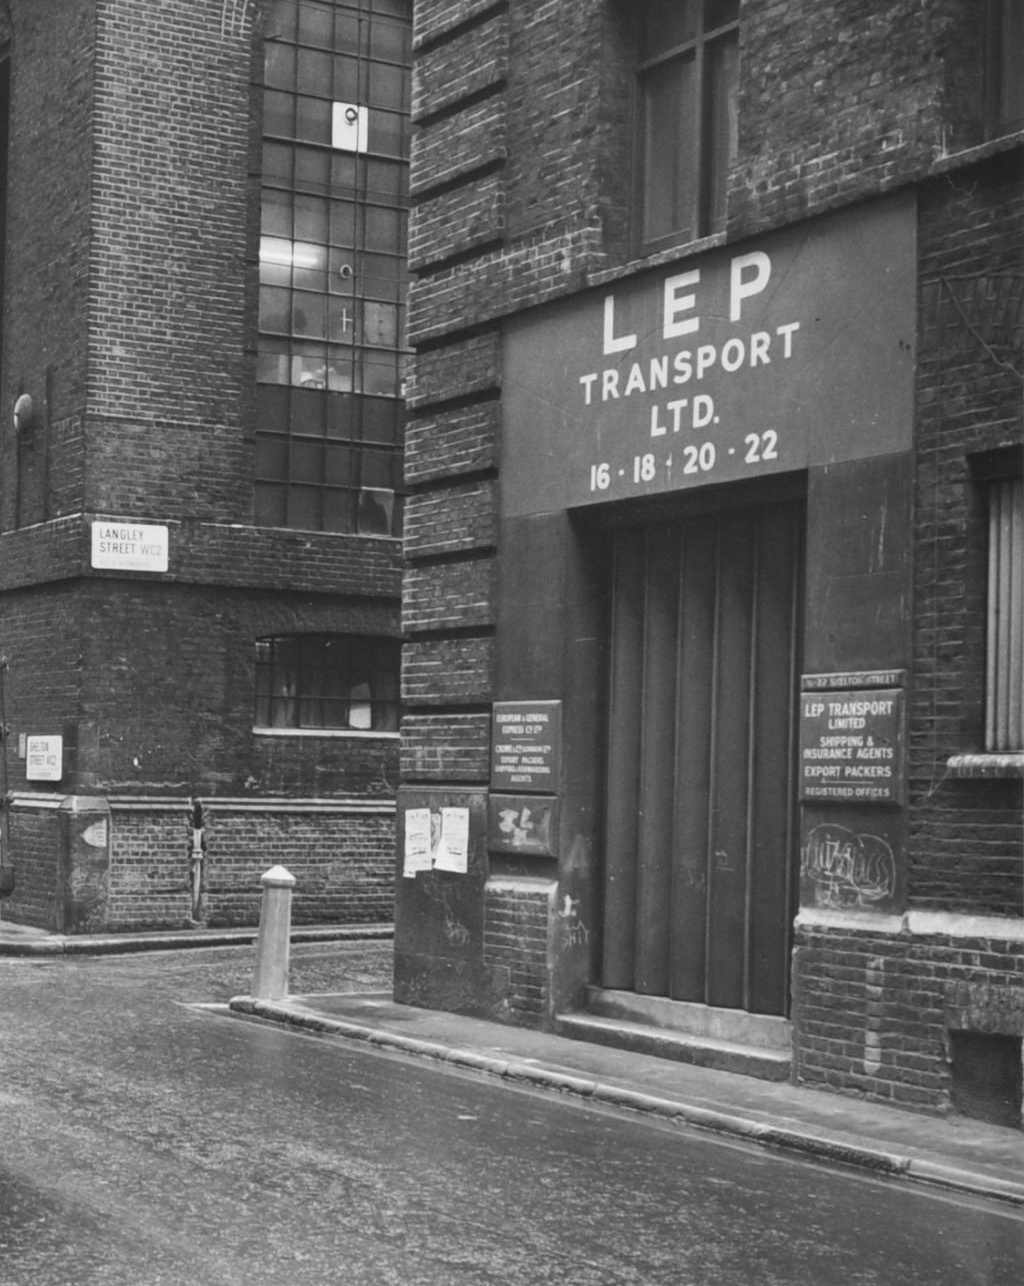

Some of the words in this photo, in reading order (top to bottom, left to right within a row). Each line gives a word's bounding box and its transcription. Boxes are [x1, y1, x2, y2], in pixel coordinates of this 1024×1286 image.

[603, 251, 772, 356] LEP
[579, 321, 801, 406] TRANSPORT
[651, 394, 720, 438] LTD.
[590, 462, 611, 492] 16
[633, 453, 657, 484] 18
[682, 441, 717, 475] 20
[744, 428, 779, 464] 22
[99, 528, 145, 541] LANGLEY
[99, 542, 136, 555] STREET
[140, 545, 162, 556] WC2
[804, 703, 825, 717] LEP
[828, 701, 893, 716] TRANSPORT
[828, 717, 866, 730] LIMITED
[820, 735, 864, 748] SHIPPING
[866, 735, 874, 747] &
[803, 748, 853, 760] INSURANCE
[856, 748, 894, 760] AGENTS
[804, 766, 841, 778] EXPORT
[844, 766, 892, 778] PACKERS
[805, 786, 854, 797] REGISTERED
[855, 787, 890, 798] OFFICES
